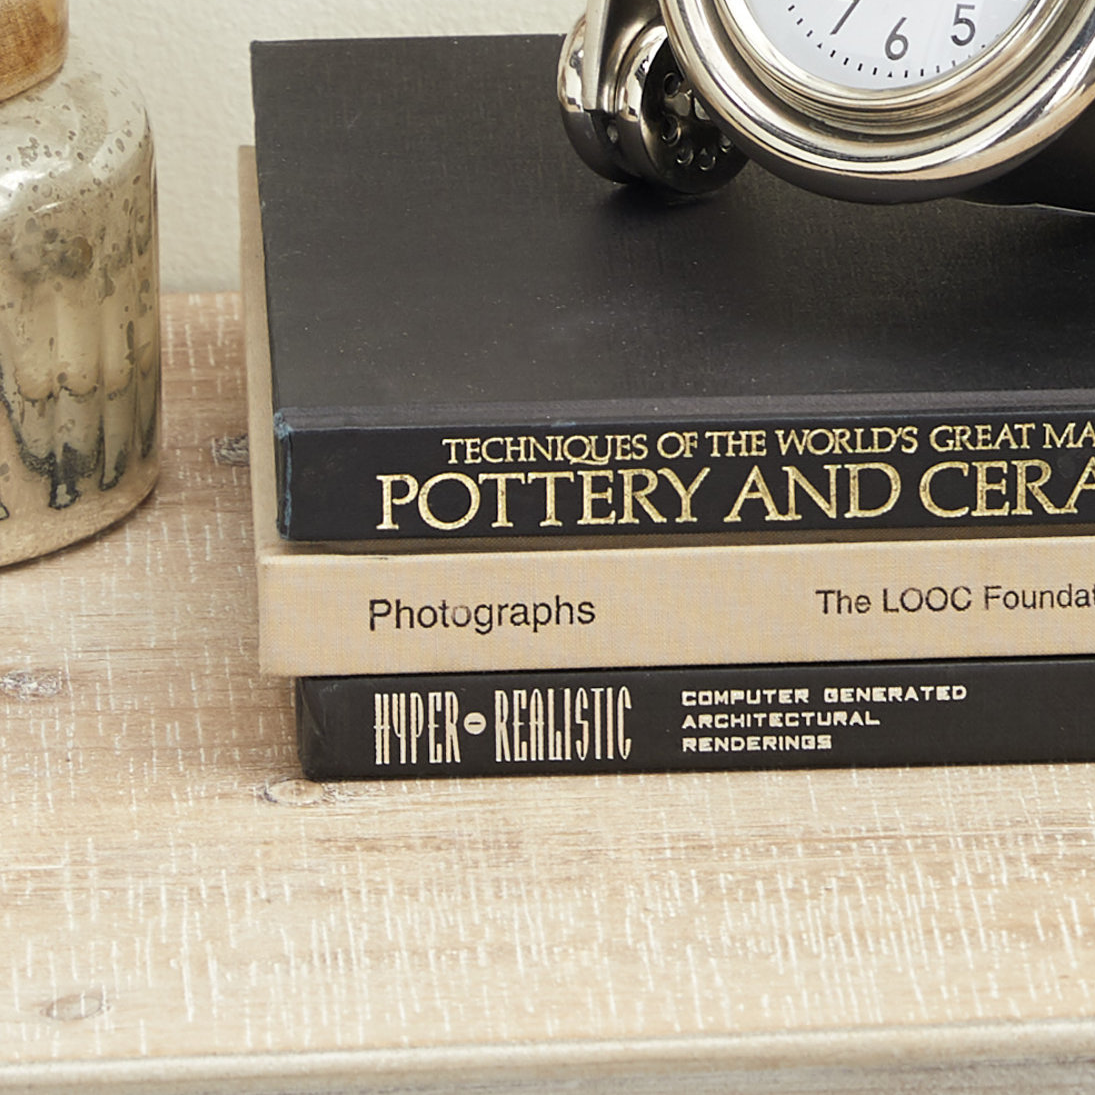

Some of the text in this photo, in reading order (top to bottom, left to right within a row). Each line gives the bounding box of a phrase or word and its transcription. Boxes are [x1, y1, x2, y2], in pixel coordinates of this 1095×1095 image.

[883, 16, 910, 61] 6
[950, 3, 977, 47] 5
[442, 433, 648, 465] TECHNIQUES
[657, 431, 698, 458] OF
[705, 430, 767, 457] THE
[775, 424, 918, 456] WORLD'S
[928, 422, 1036, 453] GREAT
[375, 467, 711, 531] POTTERY
[723, 462, 902, 523] AND
[368, 595, 596, 634] Photographs
[815, 588, 872, 614] The
[882, 585, 973, 613] LOOC
[681, 683, 968, 706] COMPUTER GENERATED
[494, 685, 632, 762] REALISTIC
[681, 710, 881, 729] ARCHITECTURAL
[682, 734, 832, 753] RENDERINGS
